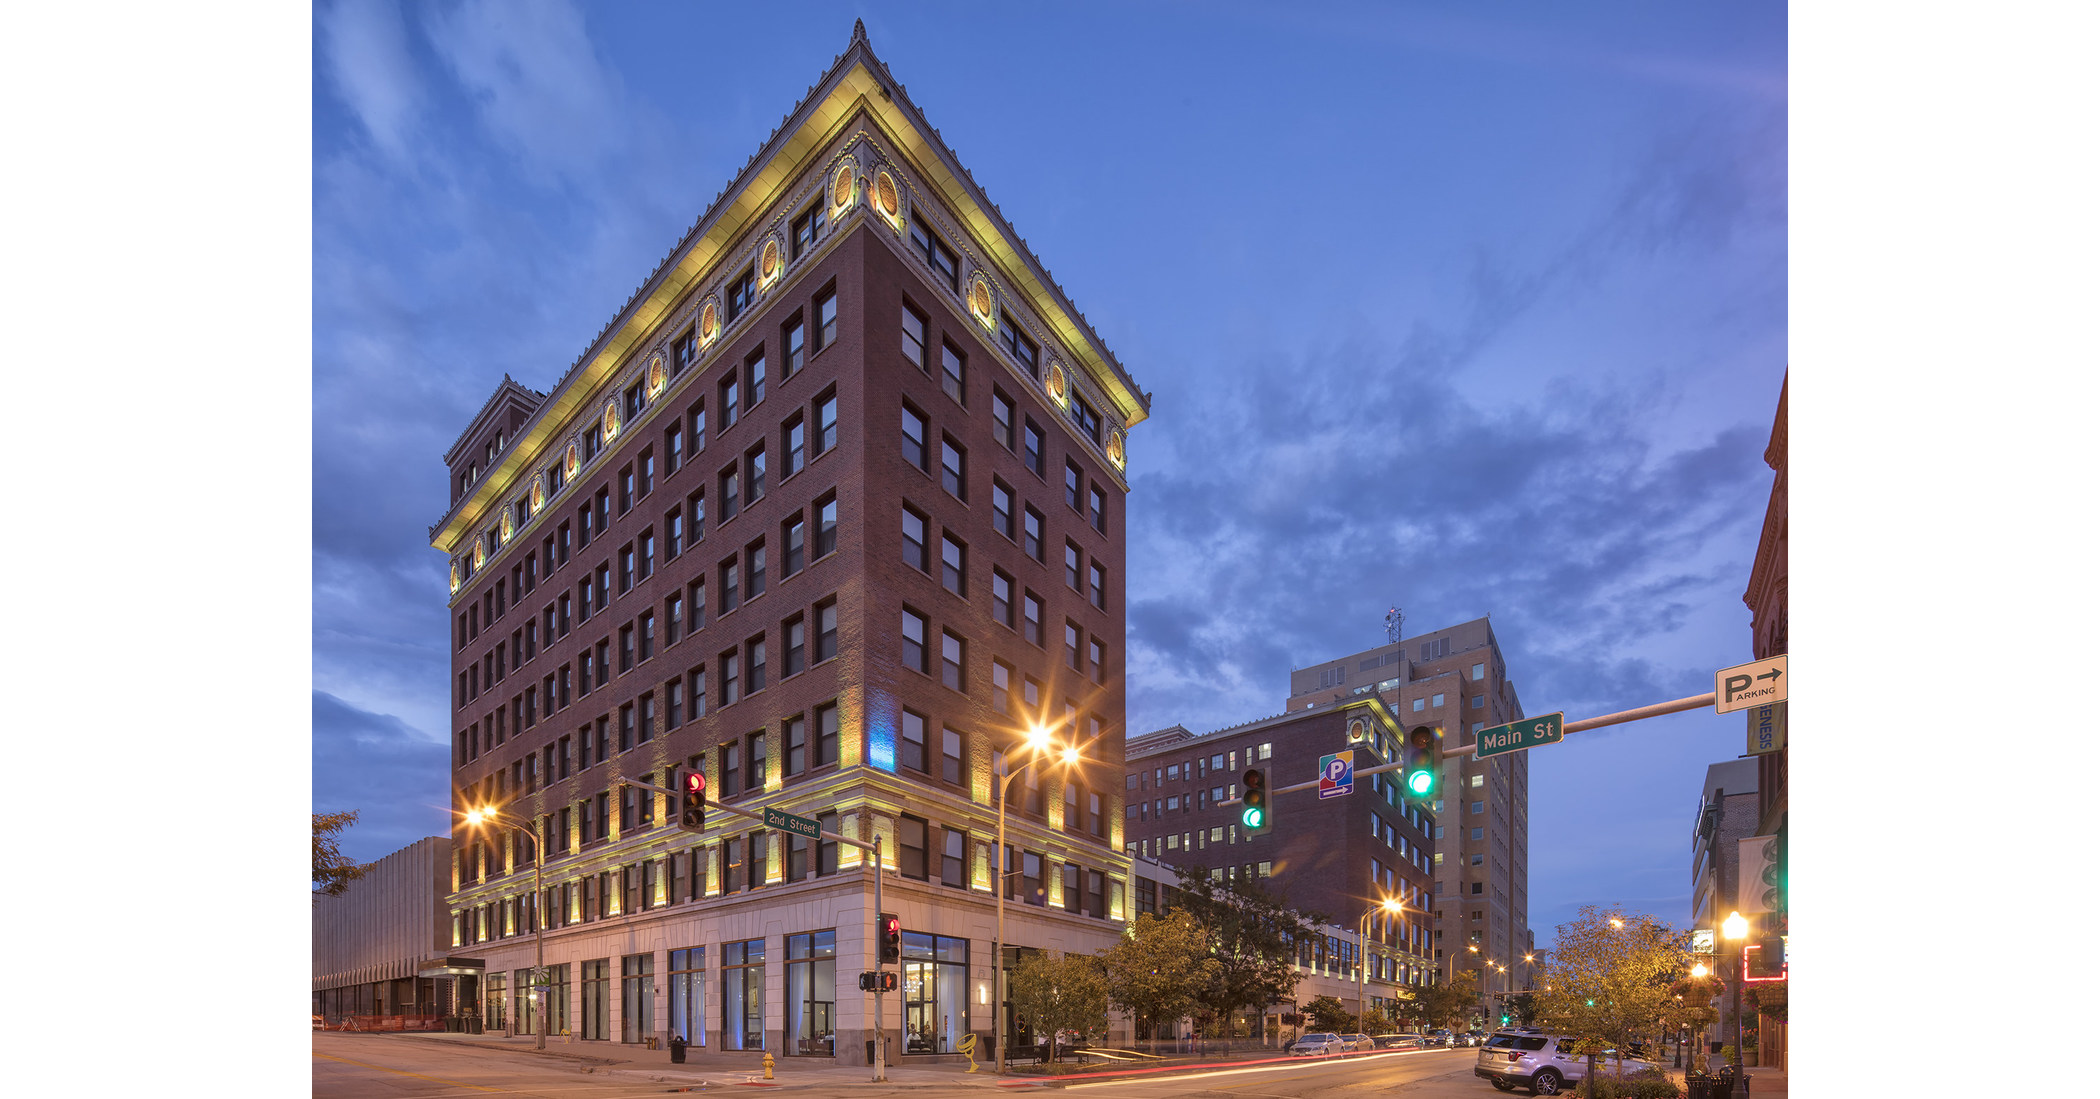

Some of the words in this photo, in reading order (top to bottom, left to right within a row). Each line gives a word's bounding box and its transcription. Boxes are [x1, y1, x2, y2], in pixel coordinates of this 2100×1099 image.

[1484, 731, 1522, 750] Main
[1534, 721, 1554, 739] St
[1330, 761, 1344, 780] P
[769, 813, 785, 826] 2nd
[790, 819, 816, 834] Street
